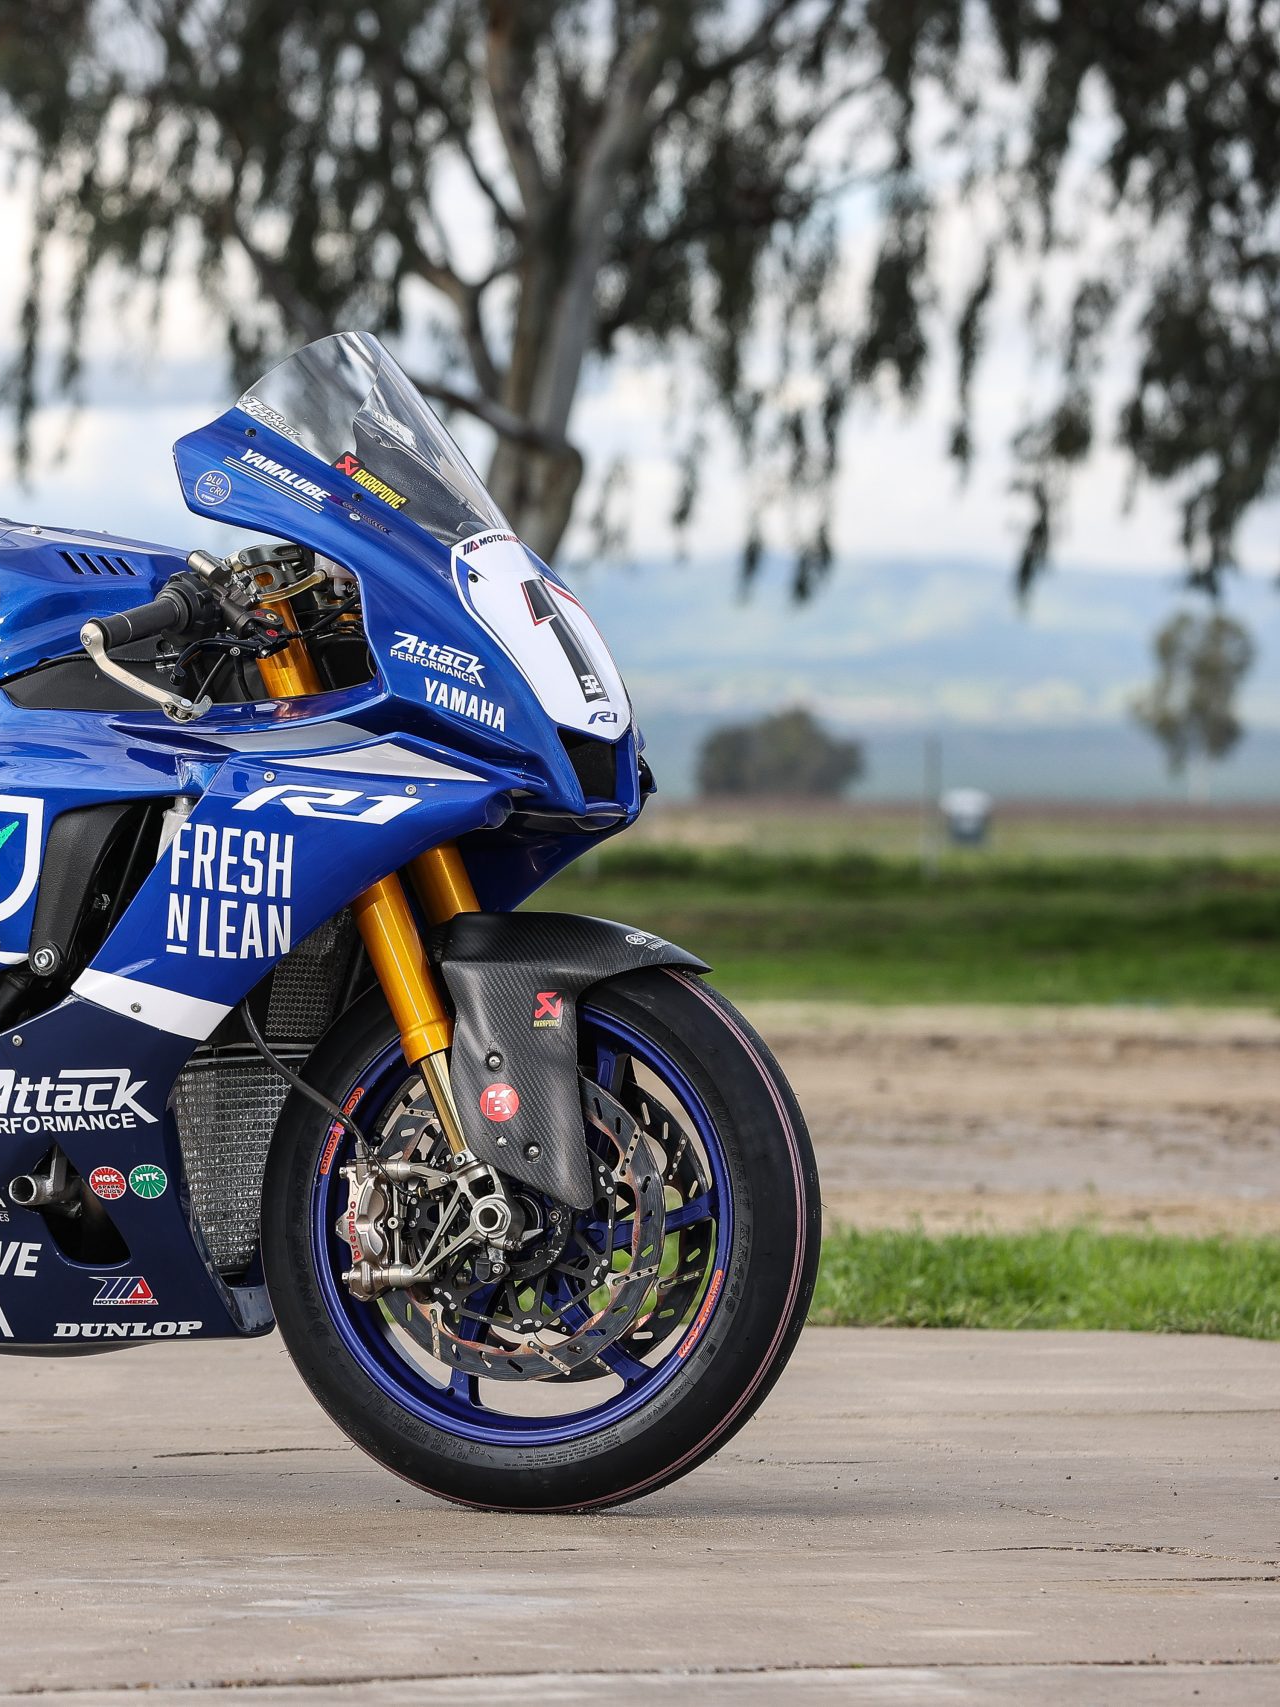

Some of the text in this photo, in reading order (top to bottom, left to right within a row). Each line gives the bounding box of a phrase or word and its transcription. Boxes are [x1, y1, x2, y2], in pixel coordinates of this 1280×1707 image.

[240, 448, 331, 502] YAMALUBE
[390, 649, 477, 686] PERFORMANCE
[391, 630, 486, 689] Attack
[424, 677, 506, 733] YAMAHA
[232, 784, 423, 825] R1
[170, 822, 294, 899] FRESH
[166, 892, 292, 960] N LEAN
[94, 1174, 119, 1184] NGK
[134, 1171, 161, 1183] NTK
[346, 1201, 362, 1262] brembo
[53, 1320, 203, 1338] DUNLOP
